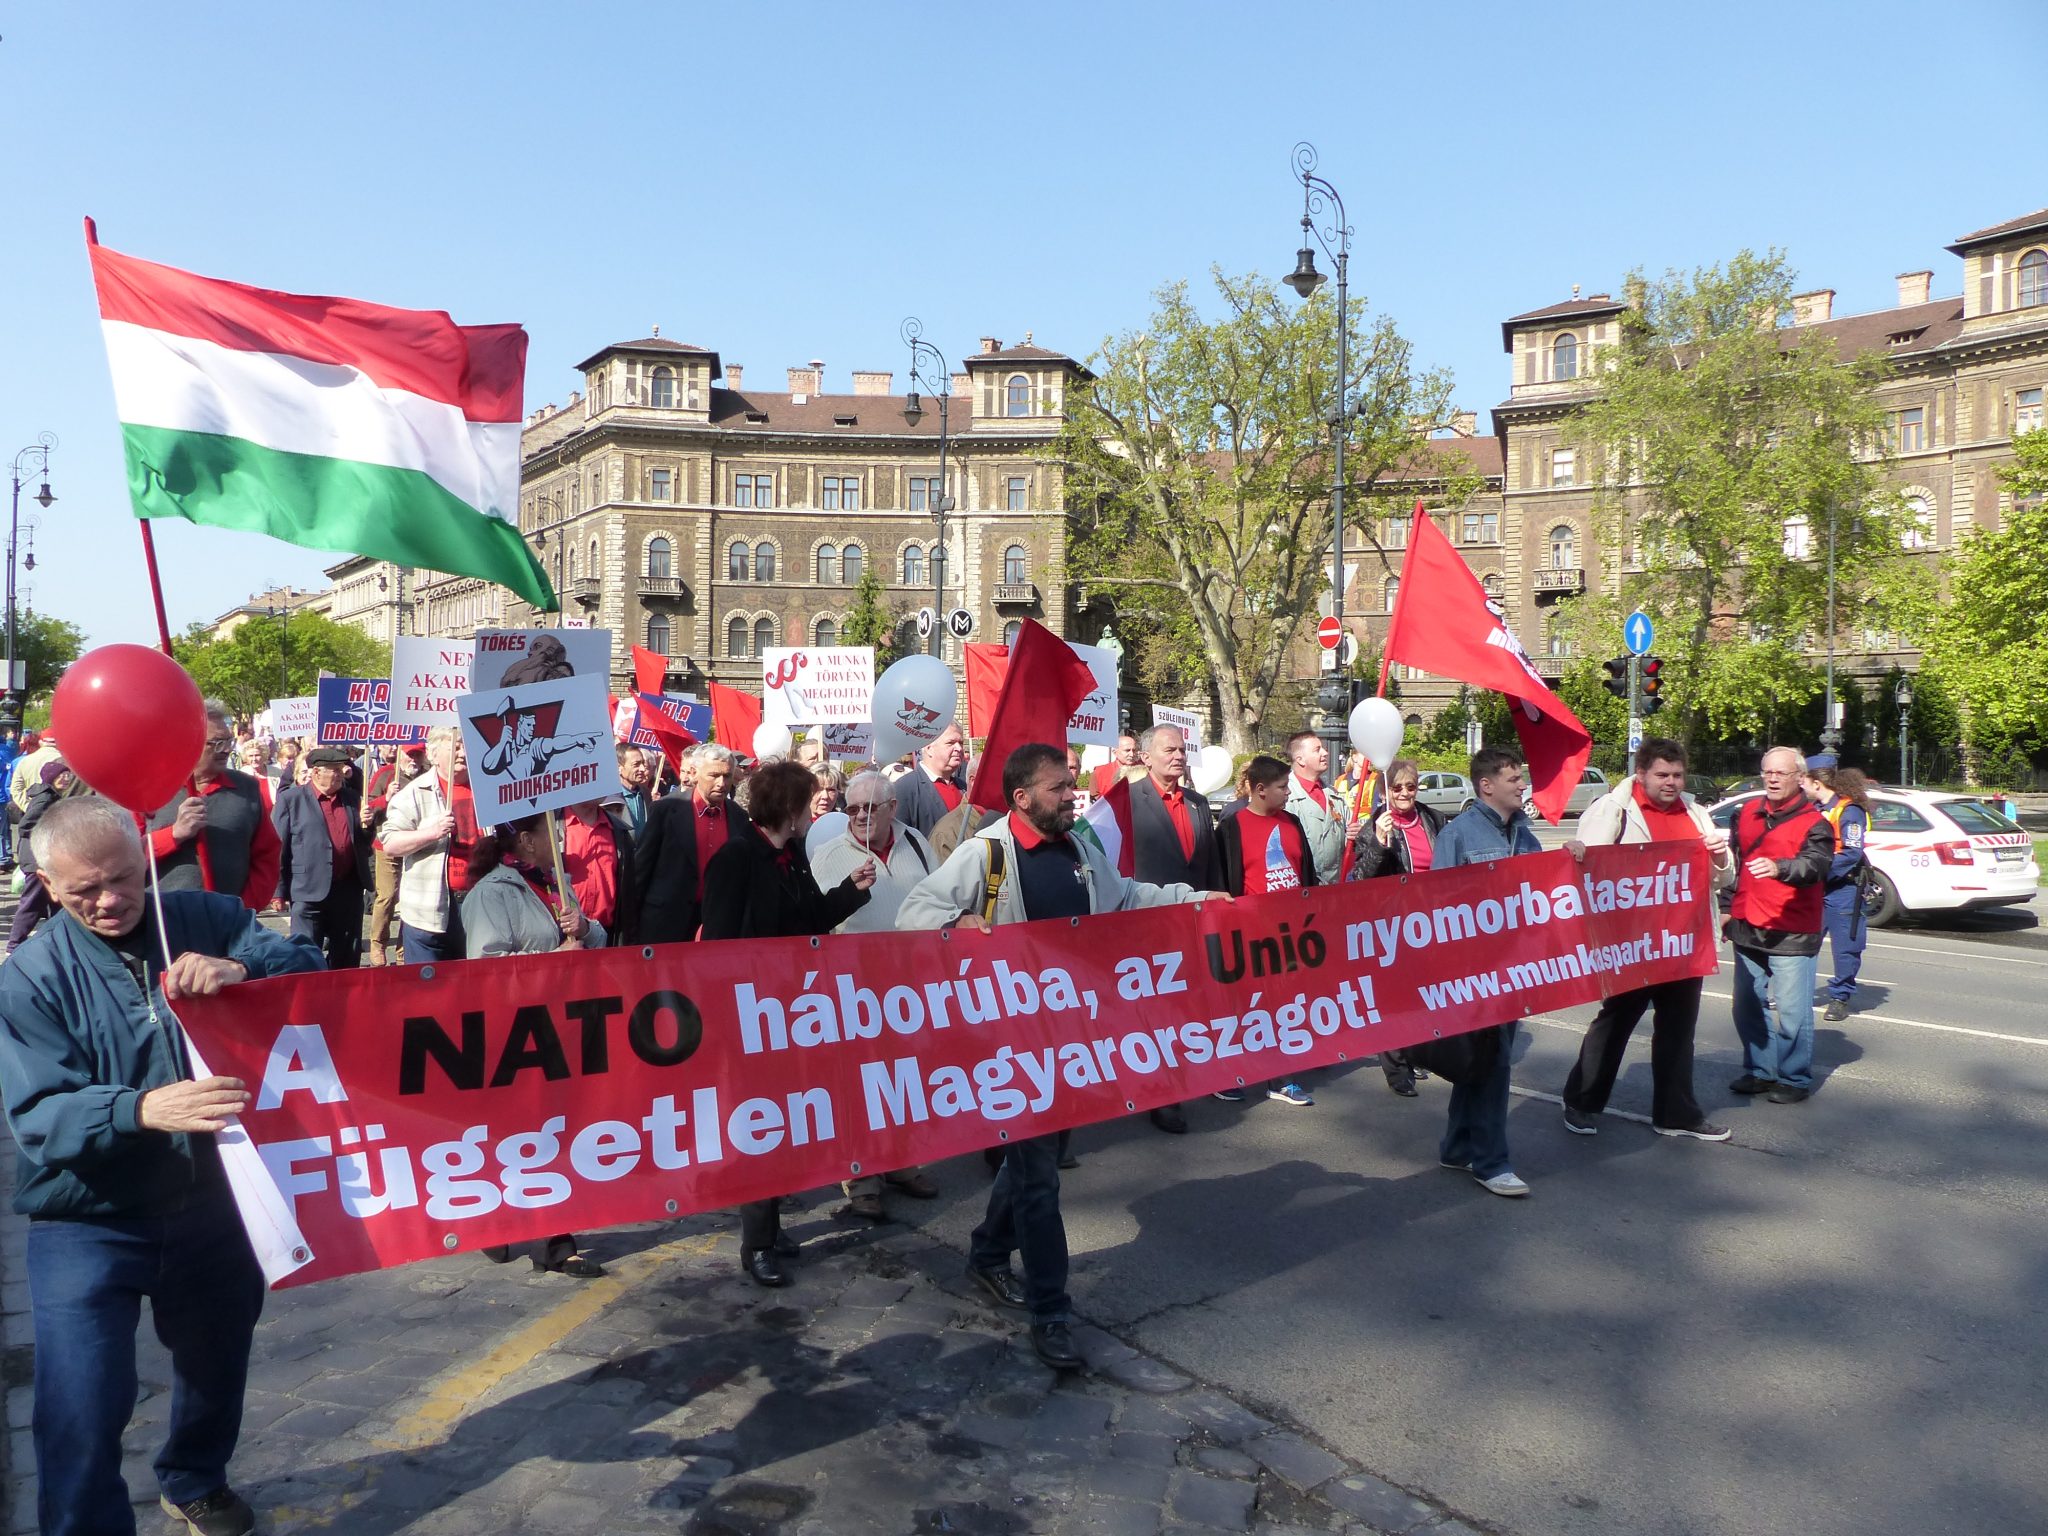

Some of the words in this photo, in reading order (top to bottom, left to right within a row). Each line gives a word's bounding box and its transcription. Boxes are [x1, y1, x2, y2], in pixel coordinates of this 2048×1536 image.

[480, 633, 527, 652] TŐKÉS
[815, 655, 823, 666] A
[827, 655, 868, 666] MUNKA
[814, 668, 868, 682] TÖRVÉNY
[348, 682, 371, 704] KI
[374, 682, 390, 703] A
[802, 687, 868, 700] MEGFOJTJA
[290, 702, 311, 710] NEM
[660, 700, 678, 720] KI
[677, 704, 692, 722] A
[812, 704, 819, 715] A
[823, 701, 868, 716] MELÓST
[498, 763, 599, 805] MUNKÁSPÁRT
[1910, 854, 1930, 868] 68
[1418, 928, 1694, 1011] www.munkaspart.hu
[255, 1024, 349, 1111] A
[399, 989, 703, 1096] NATO
[734, 957, 1099, 1055] háborúba,
[1114, 950, 1188, 1001] az
[1203, 913, 1328, 985] Unió
[1345, 881, 1584, 968] nyomorba
[1583, 860, 1694, 915] taszít!
[257, 1085, 836, 1221] Független
[859, 974, 1383, 1131] Magyarországot!
